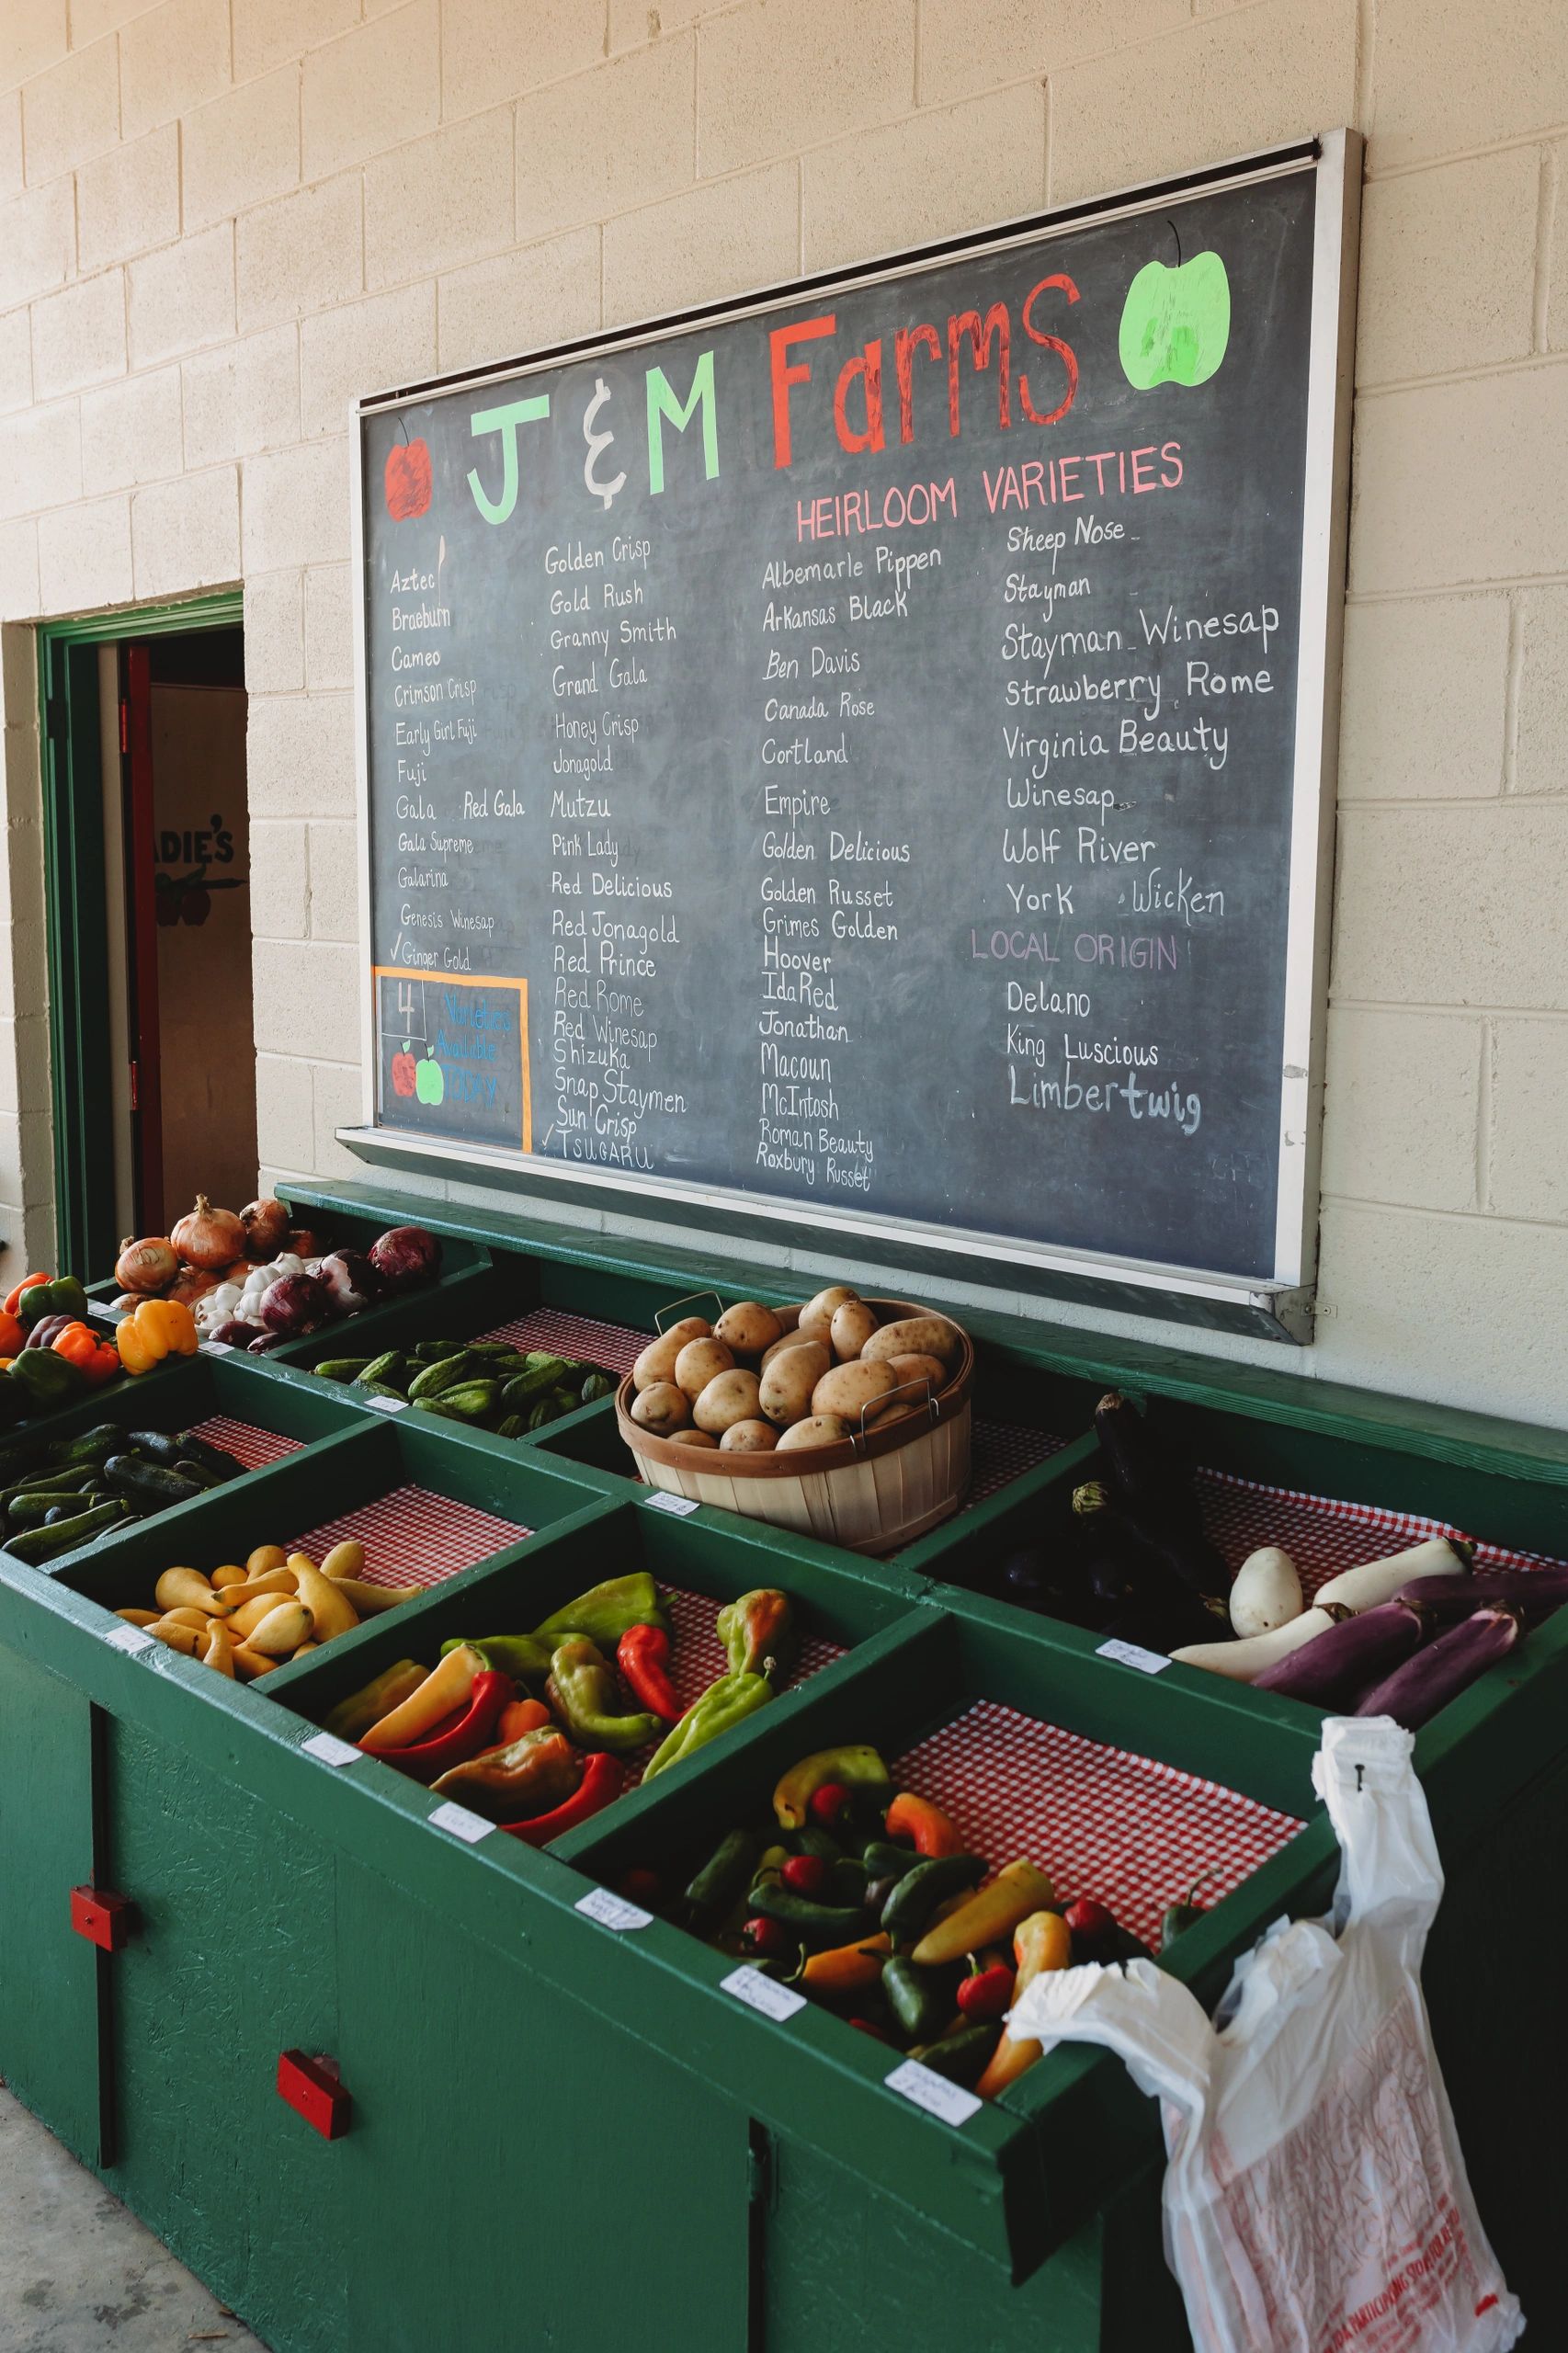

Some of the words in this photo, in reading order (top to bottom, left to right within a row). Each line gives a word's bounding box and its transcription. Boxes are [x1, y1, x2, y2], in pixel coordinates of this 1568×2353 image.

[466, 394, 550, 525] J
[582, 378, 627, 508] &
[645, 350, 719, 495] M
[797, 477, 957, 542] HEIRLOOM
[982, 443, 1184, 515] VARIETIES
[545, 541, 604, 574] Golden
[612, 536, 650, 570] Crisp
[1007, 528, 1066, 574] Sheep
[1074, 516, 1125, 545] Nose
[391, 570, 435, 594] Aztec
[762, 552, 863, 589] Albemarle
[876, 546, 941, 590] Pippen
[551, 588, 590, 615] Gold
[605, 580, 643, 607] Rush
[1005, 574, 1090, 621] Stayman
[392, 607, 450, 631] Braeburn
[551, 631, 608, 655] Granny
[620, 618, 676, 644] Smith
[392, 646, 440, 671] Cameo
[1002, 623, 1120, 679] Stayman
[1140, 606, 1278, 654] Winesap
[553, 665, 598, 697] Grand
[609, 658, 647, 688] Gala
[763, 650, 799, 679] Ben
[812, 647, 860, 677] Davis
[394, 682, 443, 708] Crimson
[448, 678, 476, 705] Crisp
[765, 698, 828, 722] Canada
[840, 692, 875, 717] Rose
[1006, 675, 1161, 721] Strawberry
[1187, 662, 1274, 697] Rome
[396, 722, 431, 756] Early
[434, 722, 455, 741] Girl
[458, 719, 477, 745] Fuji
[556, 714, 597, 745] Honey
[603, 712, 639, 742] Crisp
[553, 745, 613, 780] Jonagold
[762, 733, 849, 764] Cortland
[1004, 727, 1109, 779] Virginia
[1119, 718, 1228, 769] Beauty
[397, 760, 426, 787] Fuji
[396, 795, 437, 821] Gala
[463, 790, 488, 818] Red
[494, 790, 525, 816] Gala
[551, 790, 611, 817] Mutzu
[765, 785, 830, 828] Empire
[1007, 779, 1115, 825] Winesap
[154, 814, 234, 863] DIE'S
[398, 834, 426, 852] Gala
[430, 831, 473, 862] Supreme
[588, 830, 618, 868] Lady
[763, 832, 814, 861] Golden
[830, 831, 910, 862] Delicious
[1004, 828, 1062, 863] Wolf
[1079, 827, 1155, 863] River
[398, 868, 449, 889] Galarina
[551, 872, 582, 894] Red
[592, 873, 672, 898] Delicious
[761, 878, 816, 904] Golden
[829, 880, 893, 907] Russet
[401, 904, 443, 927] Genesis
[451, 910, 494, 937] Winesap
[552, 910, 587, 937] Red
[591, 912, 679, 953] Jonagold
[764, 908, 820, 938] Grimes
[832, 912, 898, 940] Golden
[402, 941, 438, 971] Ginger
[444, 947, 471, 971] Gold
[554, 946, 590, 973] Red
[600, 940, 656, 977] Prince
[764, 936, 832, 972] Hoover
[971, 930, 1060, 962] LOCAL
[1075, 934, 1176, 969] ORIGIN
[399, 982, 415, 1033] 4
[554, 978, 590, 1009] Red
[597, 980, 644, 1016] Rome
[1007, 982, 1090, 1017] Delano
[437, 1029, 497, 1060] Available
[553, 1011, 585, 1040] Red
[592, 1014, 657, 1062] Winesap
[759, 1011, 853, 1042] Jonathan
[1007, 1024, 1044, 1066] King
[1065, 1034, 1158, 1065] Luscious
[761, 1043, 832, 1082] Macoun
[443, 1063, 497, 1109] TODAY
[554, 1067, 598, 1115] Snap
[763, 1084, 838, 1120] McIntosh
[595, 1105, 637, 1142] Crisp
[760, 1119, 812, 1151] Roman
[819, 1130, 873, 1162] Beauty
[756, 1143, 815, 1184] Roxbury
[827, 1157, 870, 1190] Russet
